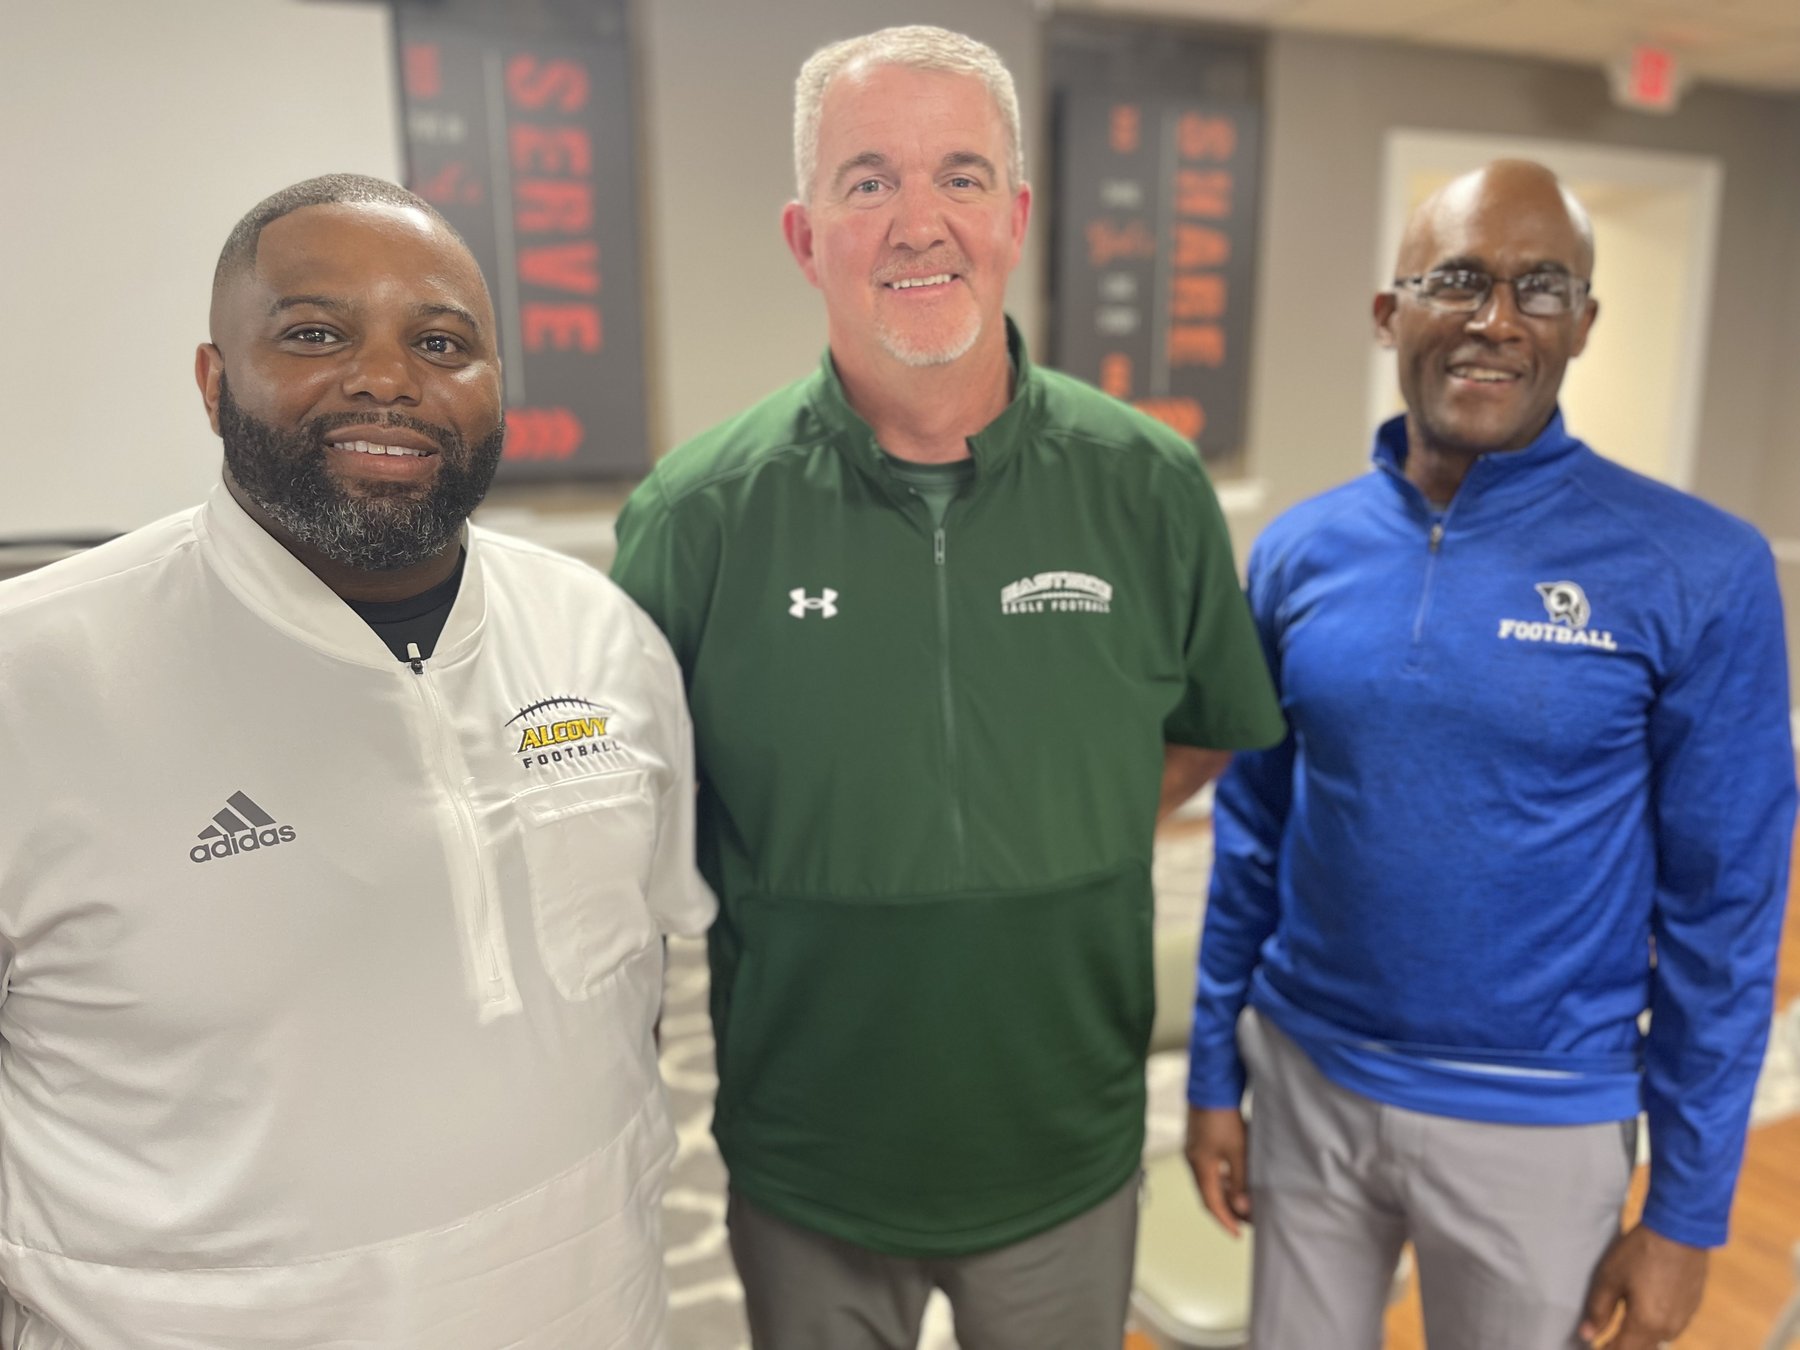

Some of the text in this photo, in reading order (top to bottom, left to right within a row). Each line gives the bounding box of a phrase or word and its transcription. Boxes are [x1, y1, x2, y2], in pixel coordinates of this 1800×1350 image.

[505, 52, 600, 354] SERVE
[1167, 112, 1236, 367] SHARE
[1002, 599, 1110, 614] EAGLE FOOTBALL
[1498, 619, 1617, 651] FOOTBALL
[518, 717, 608, 753] ALCOVY
[523, 741, 621, 768] FOOTBALL
[190, 825, 296, 863] adidas
